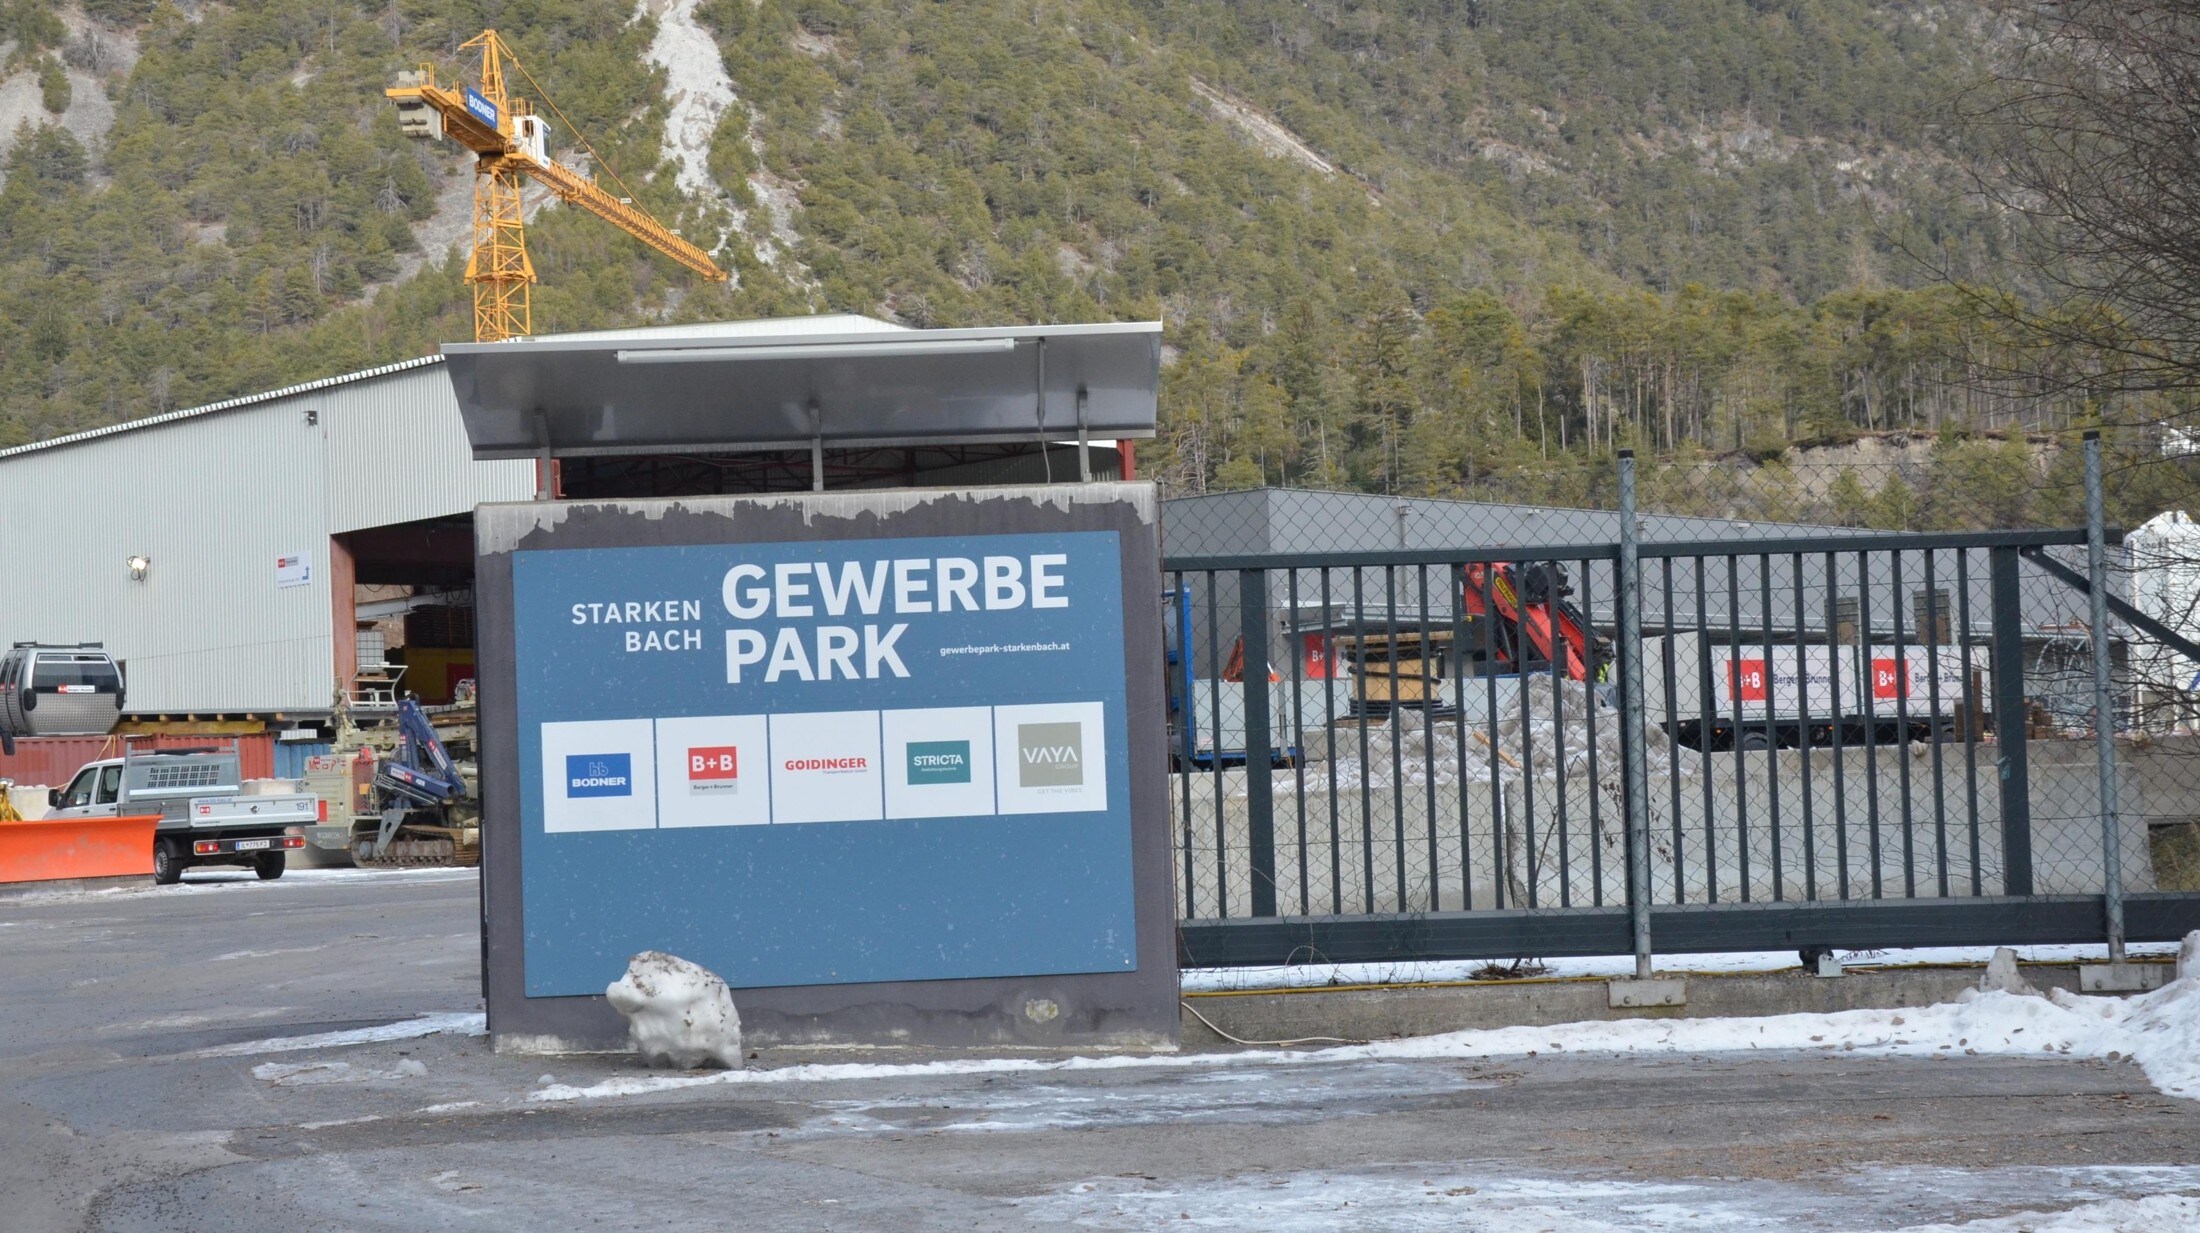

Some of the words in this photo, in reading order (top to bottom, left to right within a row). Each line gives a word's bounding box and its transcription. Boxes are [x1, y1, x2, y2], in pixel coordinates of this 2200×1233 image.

[469, 94, 496, 122] BODNER
[722, 554, 1069, 620] GEWERBE
[571, 600, 701, 625] STARKEN
[625, 629, 702, 652] BACH
[725, 623, 911, 684] PARK
[940, 642, 1070, 657] gewerbepark-starkenbach.at
[1312, 650, 1325, 663] B+
[1805, 673, 1832, 684] Brunne
[1879, 670, 1895, 687] B+
[913, 754, 964, 767] STRICTA
[1022, 745, 1079, 764] VAYA
[692, 754, 734, 773] B+B
[785, 757, 867, 771] GOIDINGER
[572, 776, 627, 788] BODNER
[296, 802, 309, 811] 191
